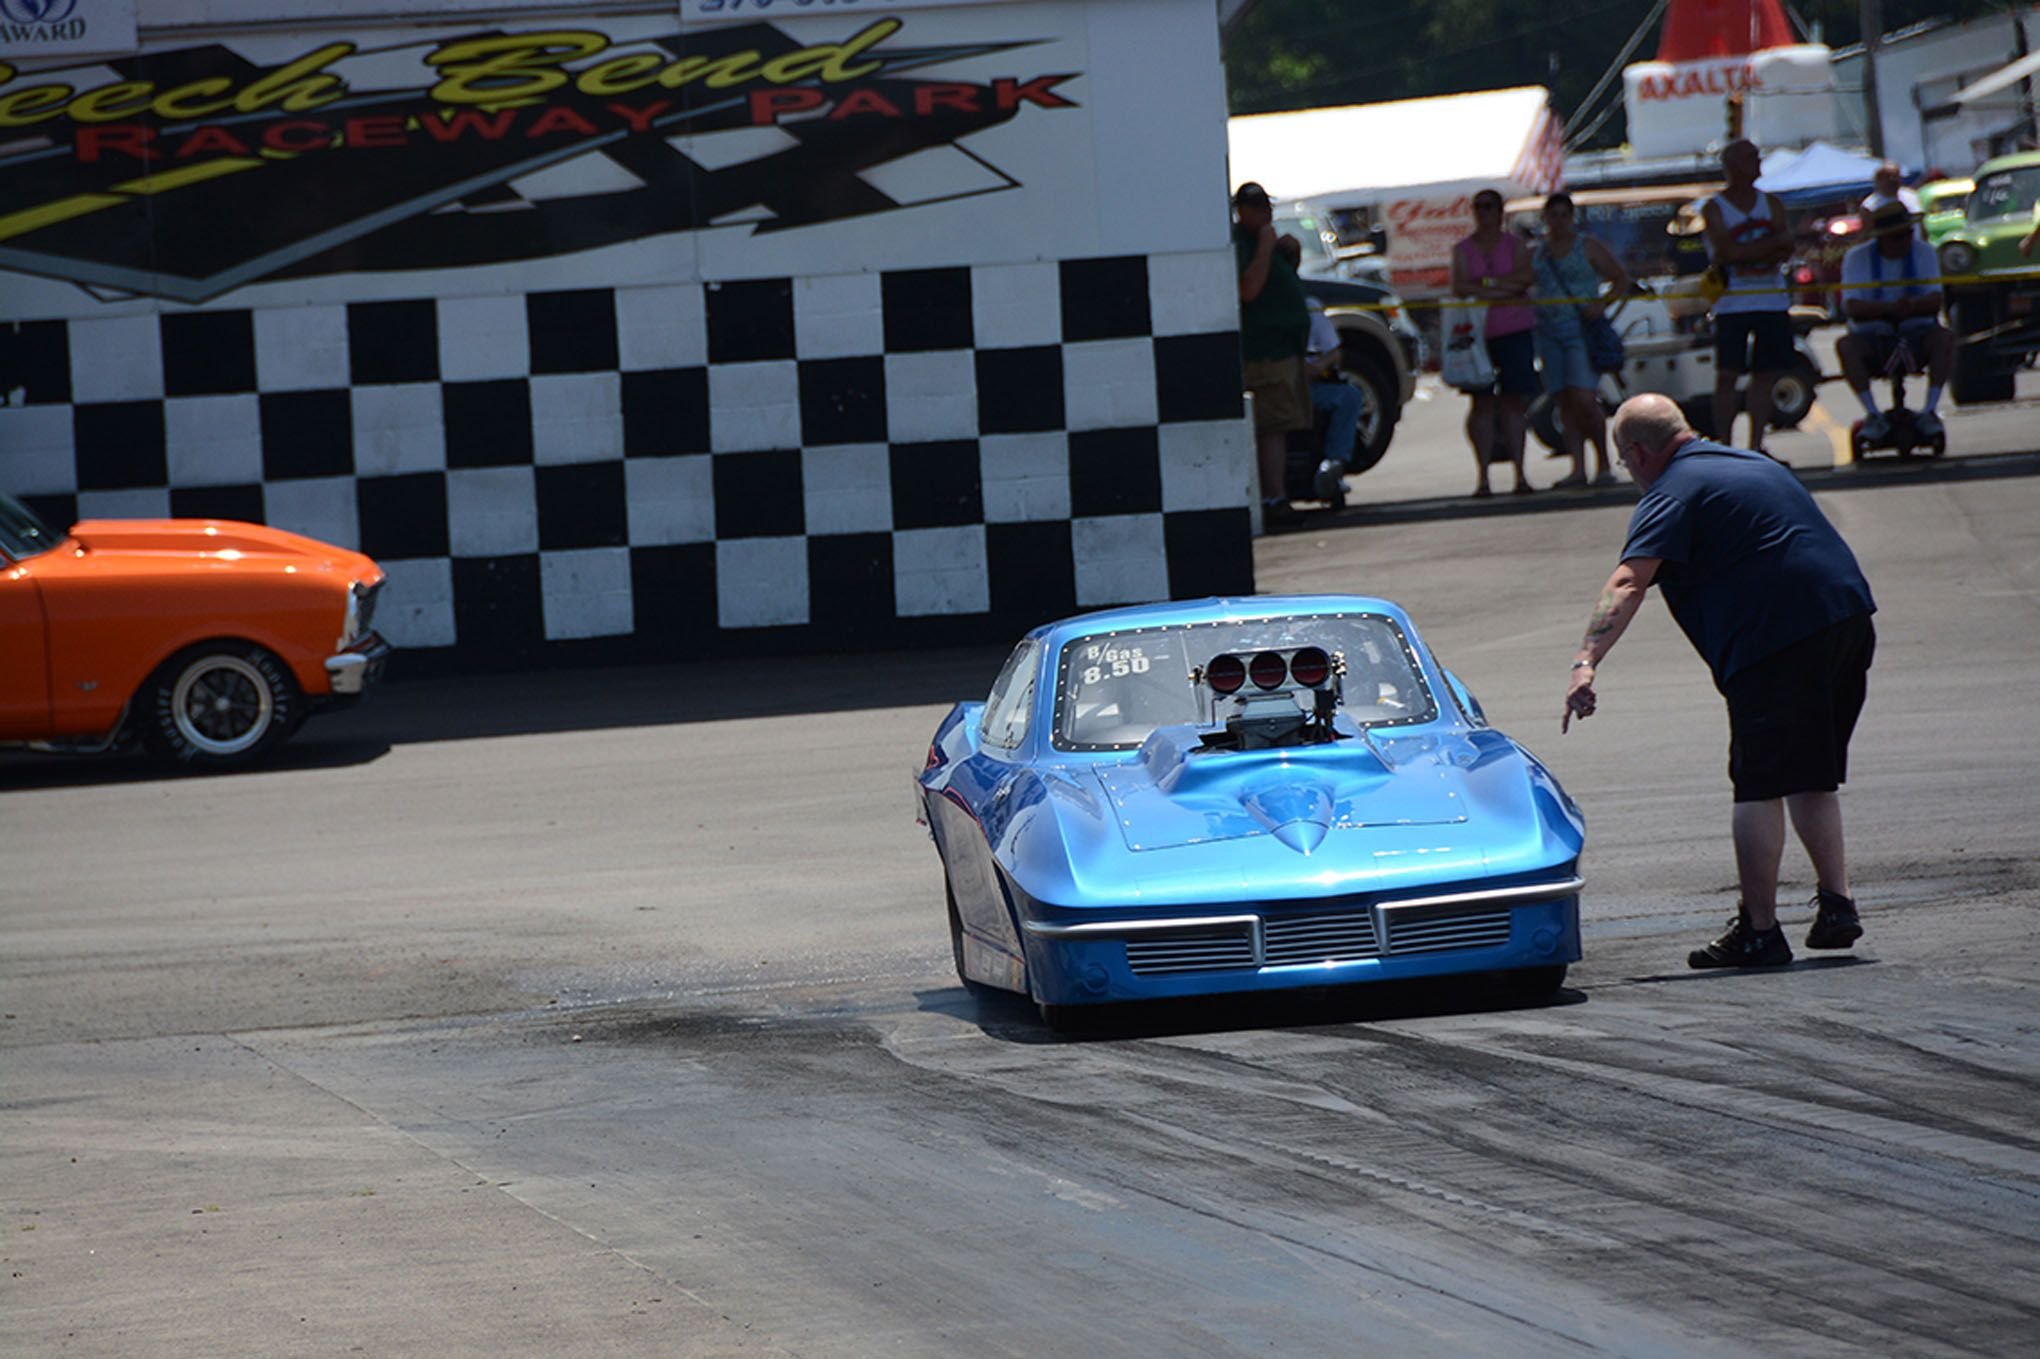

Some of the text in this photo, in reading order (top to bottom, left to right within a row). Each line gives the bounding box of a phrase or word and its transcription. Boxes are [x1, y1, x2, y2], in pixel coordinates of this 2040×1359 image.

[0, 16, 904, 127] eech Bend
[1637, 64, 1765, 103] AXALTA
[75, 71, 1087, 164] RACEWAY PARK
[1083, 656, 1151, 686] 8.50
